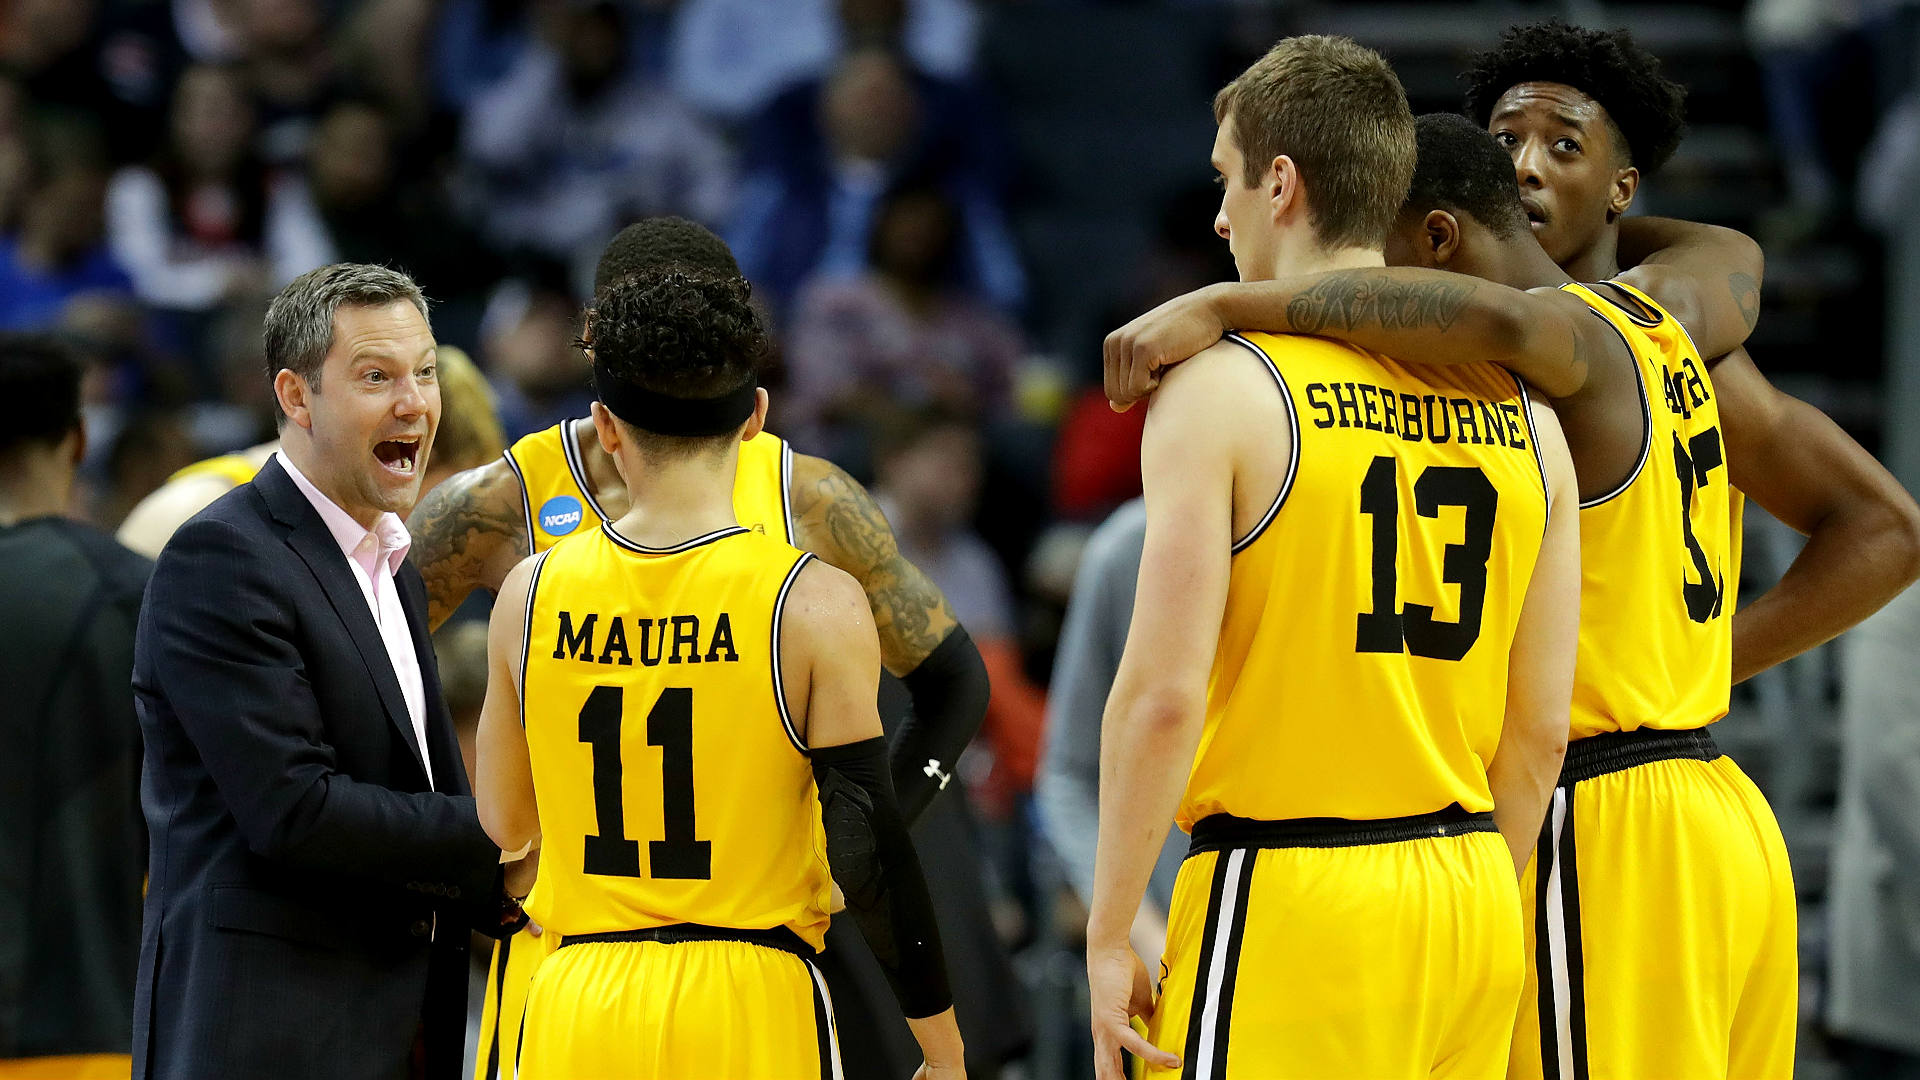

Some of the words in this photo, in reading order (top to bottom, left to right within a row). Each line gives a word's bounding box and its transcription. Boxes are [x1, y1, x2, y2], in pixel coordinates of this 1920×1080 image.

[1306, 382, 1526, 450] SHERBURNE
[543, 510, 580, 528] NCAA
[1355, 455, 1499, 662] 13
[552, 610, 739, 667] MAURA
[578, 685, 712, 881] 11
